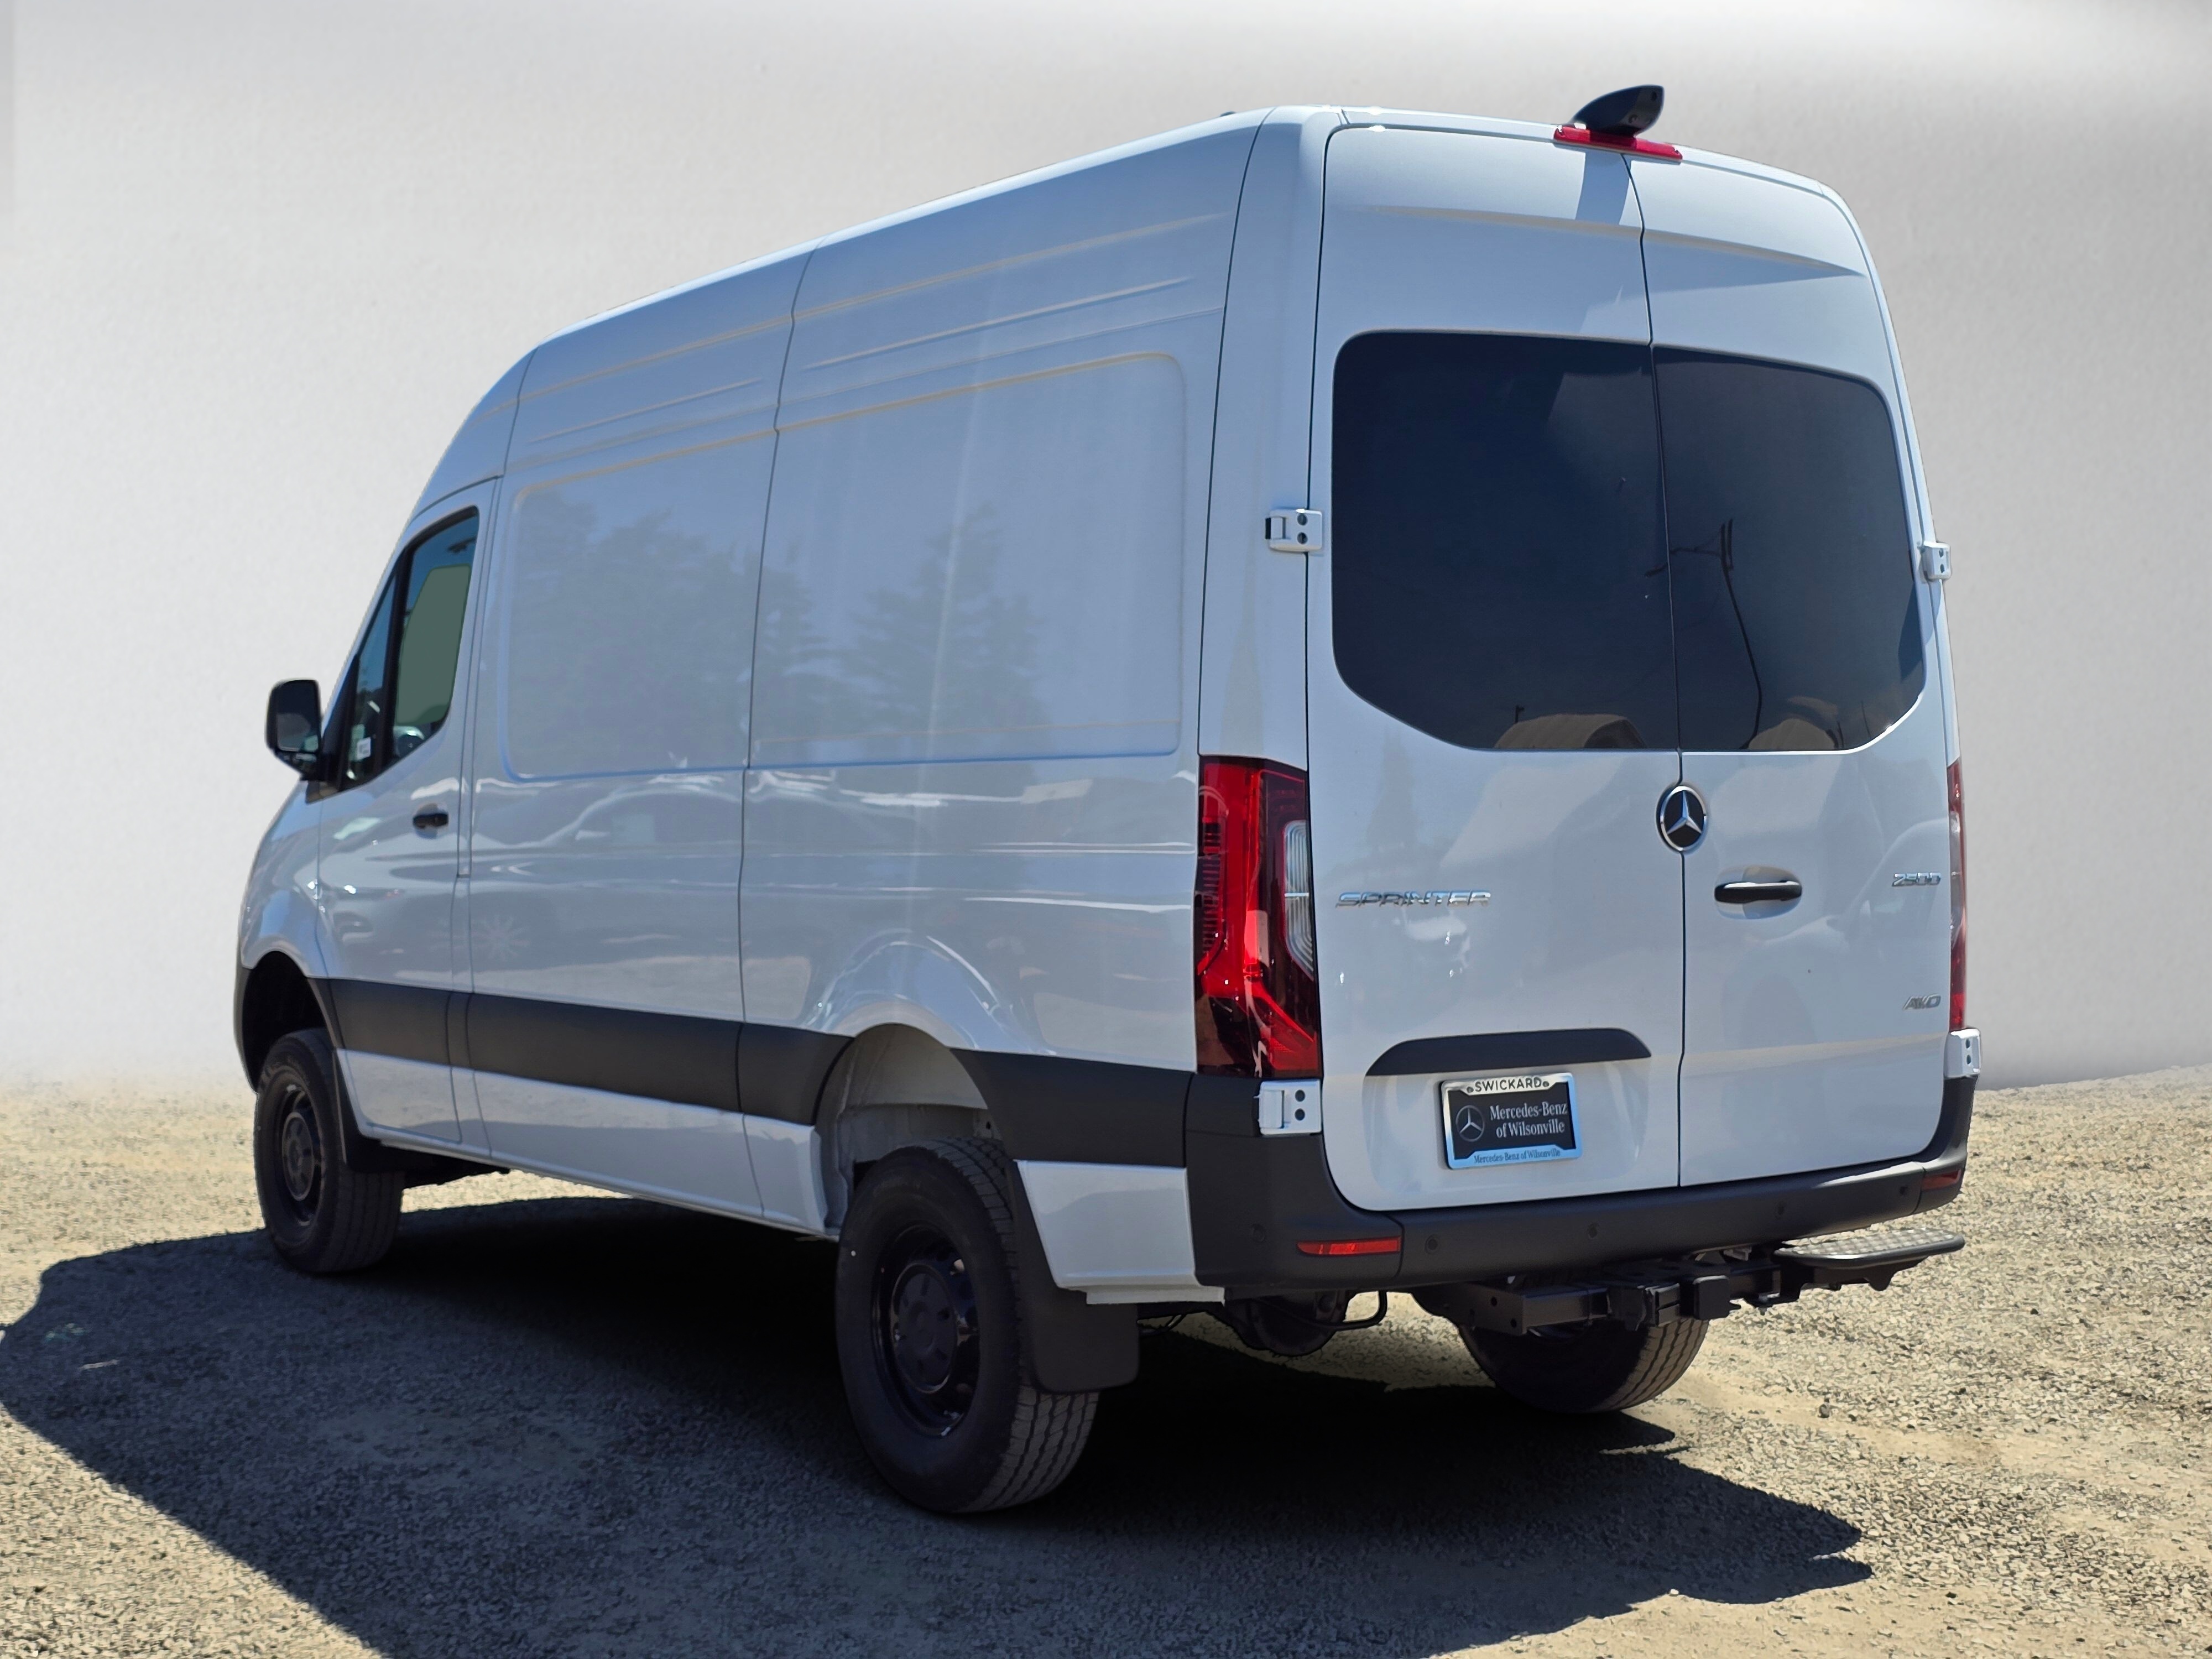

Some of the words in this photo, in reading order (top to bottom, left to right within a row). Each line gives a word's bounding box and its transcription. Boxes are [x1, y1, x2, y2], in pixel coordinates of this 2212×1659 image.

[1892, 872, 1941, 887] 2500
[1335, 890, 1491, 907] SPRINTER
[1475, 1077, 1542, 1093] SWICKARD
[1490, 1102, 1568, 1121] Mercedes-Benz
[1496, 1123, 1508, 1138] of
[1508, 1119, 1566, 1136] Wilsonville
[1474, 1150, 1520, 1164] Mercedes-Benz
[1520, 1150, 1527, 1159] of
[1527, 1148, 1561, 1158] Wilsonville
